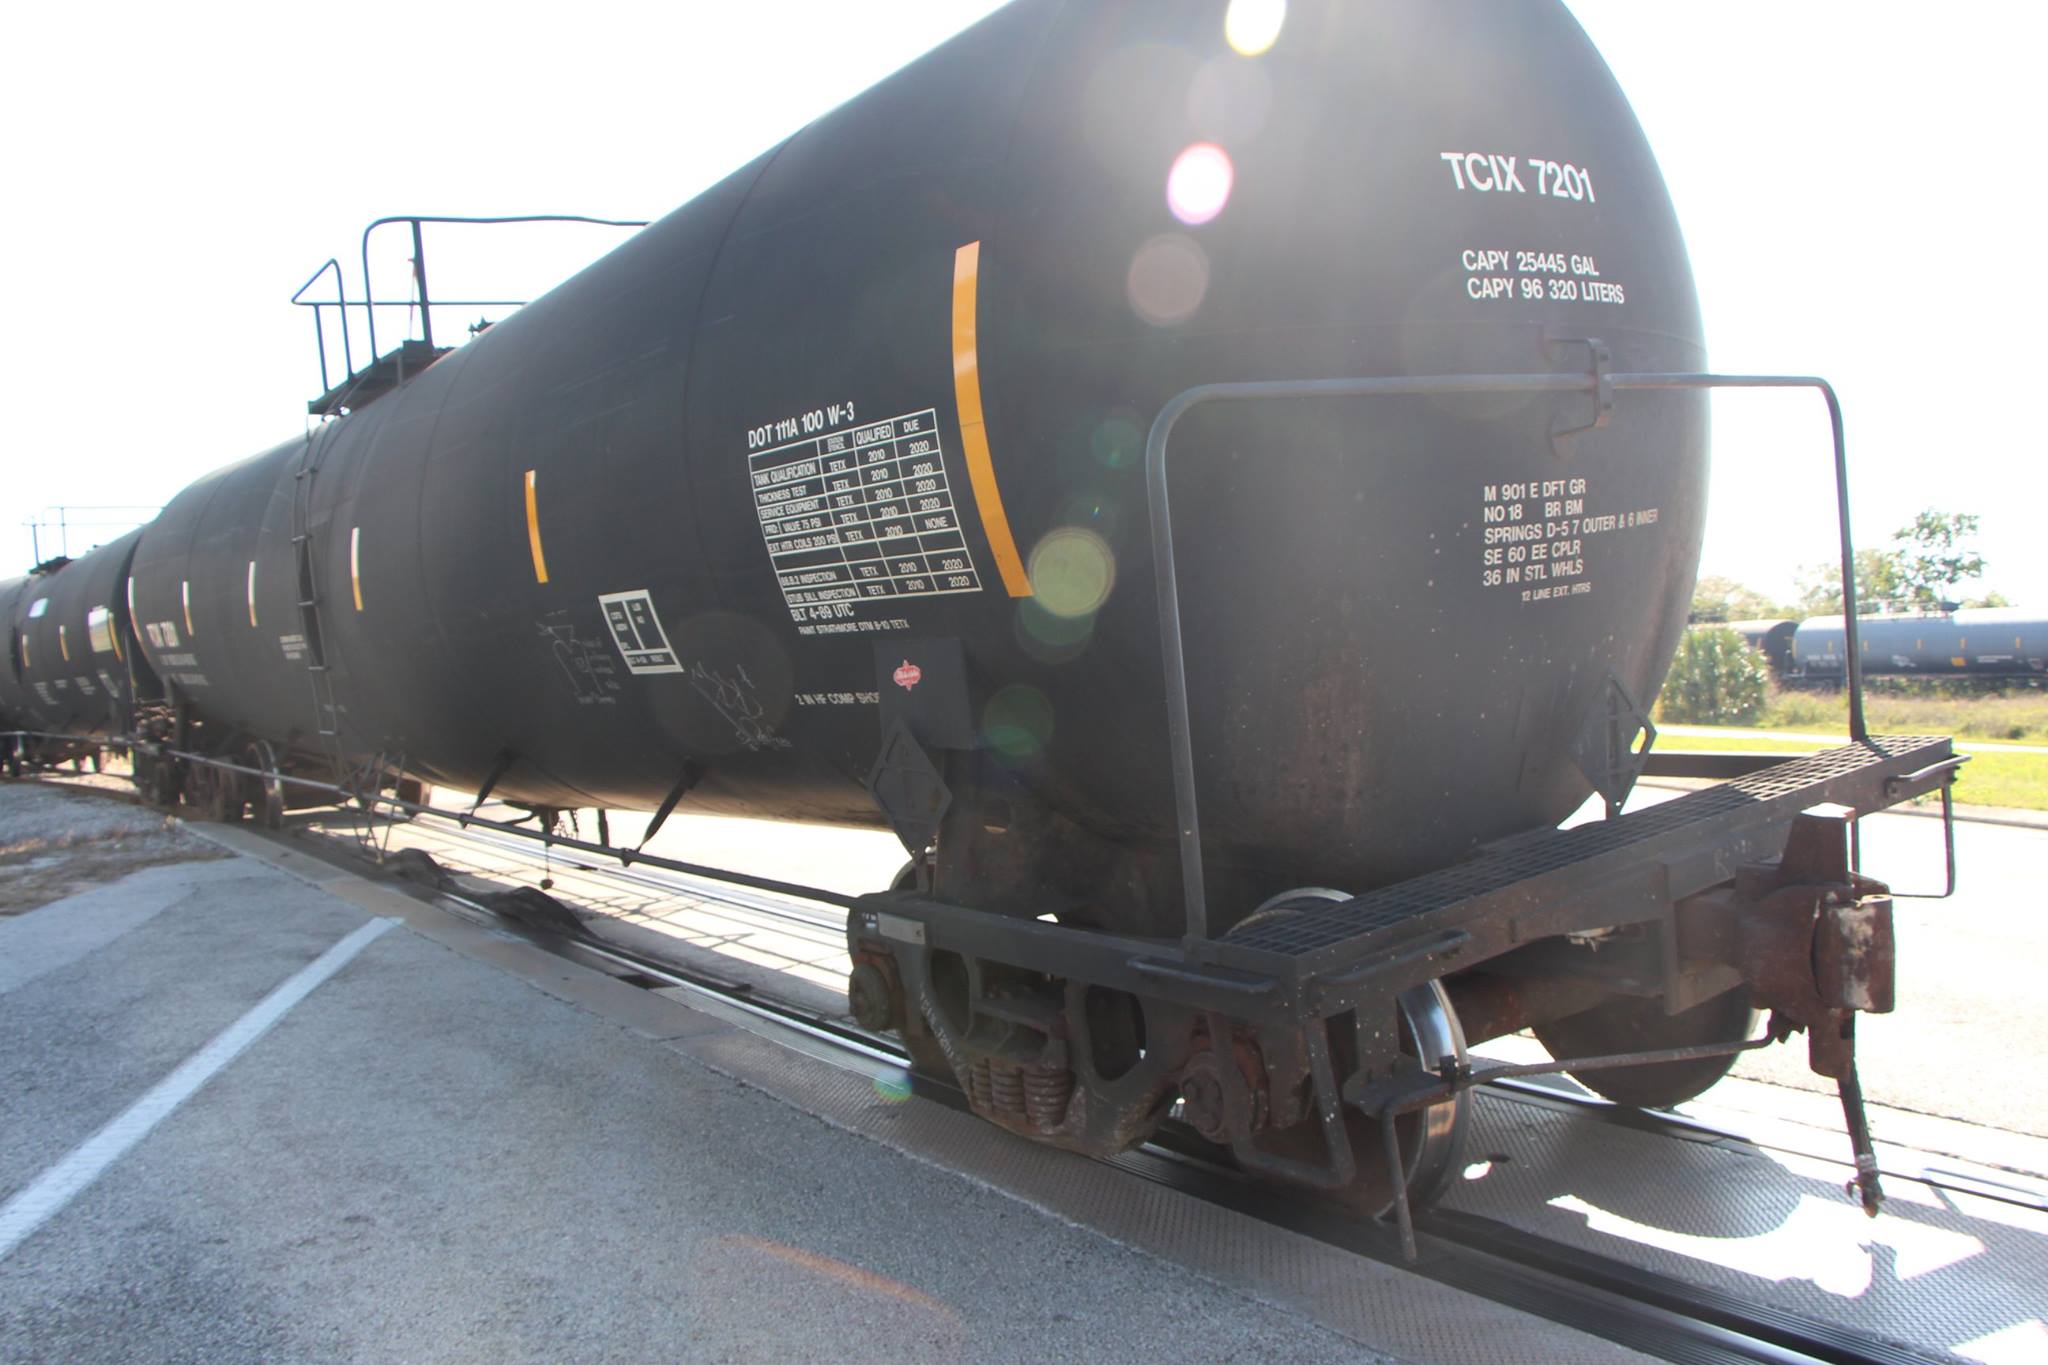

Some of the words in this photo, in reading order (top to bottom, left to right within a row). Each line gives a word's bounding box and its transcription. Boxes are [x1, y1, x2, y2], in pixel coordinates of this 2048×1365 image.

[1440, 152, 1525, 192] TCIX
[1528, 159, 1595, 202] 7201
[1462, 249, 1509, 272] CAPY
[1516, 251, 1567, 273] 25445
[1571, 254, 1600, 276] GAL
[1467, 277, 1515, 299] CAPY
[1521, 279, 1543, 299] 96
[1548, 279, 1577, 300] 320
[1581, 281, 1625, 304] LITERS
[748, 424, 772, 448] DOT
[775, 418, 798, 440] 111A
[802, 410, 823, 432] 100
[827, 401, 854, 426] W-3
[856, 425, 892, 445] QUALIFIED
[903, 419, 920, 432] DUE
[754, 473, 770, 486] TANK
[770, 462, 816, 483] QUALIFICATION
[829, 460, 846, 472] TETX
[868, 449, 886, 462] 2010
[909, 440, 929, 454] 2020
[791, 485, 806, 496] TEST
[832, 479, 850, 491] TETX
[870, 468, 888, 481] 2010
[912, 462, 933, 476] 2020
[1484, 486, 1496, 502] M
[1502, 484, 1526, 500] 901
[1530, 482, 1538, 498] E
[1543, 480, 1566, 497] DFT
[1569, 478, 1586, 495] GR
[760, 506, 785, 520] SERVICE
[785, 499, 819, 515] EQUIPMENT
[836, 495, 854, 506] TETX
[875, 488, 893, 500] 2010
[916, 479, 936, 492] 2020
[840, 512, 858, 524] TETX
[880, 506, 898, 518] 2010
[920, 498, 940, 510] 2020
[1484, 506, 1505, 522] NO
[1508, 504, 1522, 520] 18
[1545, 502, 1562, 518] BR
[1565, 500, 1583, 516] BM
[885, 525, 903, 537] 2010
[925, 516, 948, 530] NONE
[1484, 524, 1542, 544] SPRINGS
[1546, 520, 1569, 538] D-5
[1573, 520, 1580, 535] 7
[1582, 514, 1616, 534] OUTER
[1484, 549, 1502, 566] SE
[1508, 546, 1526, 563] 60
[1532, 544, 1548, 560] EE
[1552, 539, 1581, 558] CPLR
[859, 566, 879, 576] TETX
[898, 562, 917, 574] 2010
[942, 558, 963, 570] 2020
[1482, 569, 1502, 586] 36
[1506, 568, 1520, 584] IN
[1524, 564, 1547, 581] STL
[1552, 558, 1584, 578] WHLS
[906, 580, 925, 590] 2010
[948, 576, 970, 587] 2020
[1533, 587, 1552, 600] LINE
[790, 608, 808, 622] BLT
[809, 606, 832, 620] 4-89
[832, 603, 854, 618] UTC
